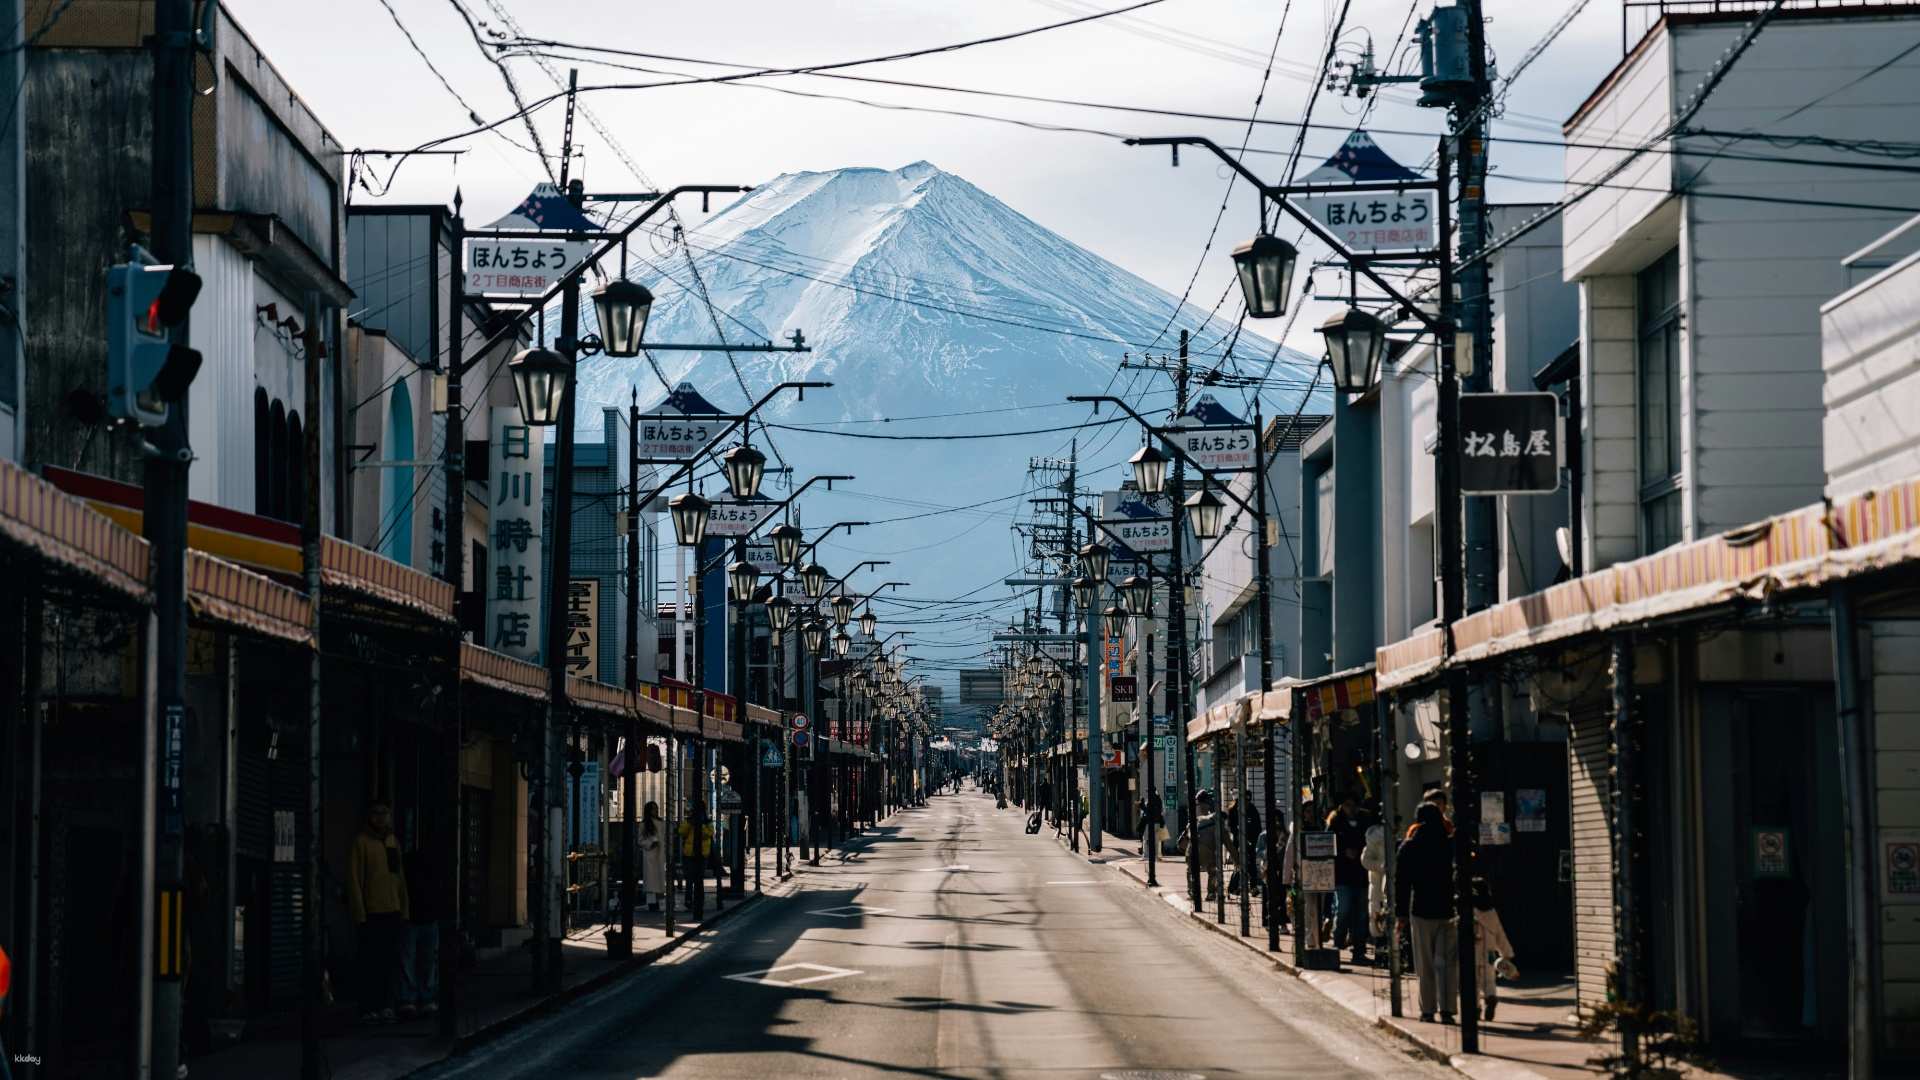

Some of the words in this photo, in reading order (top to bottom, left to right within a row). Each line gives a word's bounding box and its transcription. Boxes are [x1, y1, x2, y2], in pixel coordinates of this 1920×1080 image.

[1326, 198, 1429, 225] ほんちょう
[1346, 227, 1428, 245] 2丁目商店街
[472, 245, 567, 270] ほんちょう
[471, 274, 548, 289] 2丁目商店街
[644, 425, 708, 442] ほんちょう
[1187, 434, 1250, 452] ほんちょう
[1463, 429, 1552, 457] 松島屋
[708, 509, 758, 522] ほんちょう
[494, 425, 533, 649] 日川時計店
[1122, 525, 1170, 538] ほんちょう
